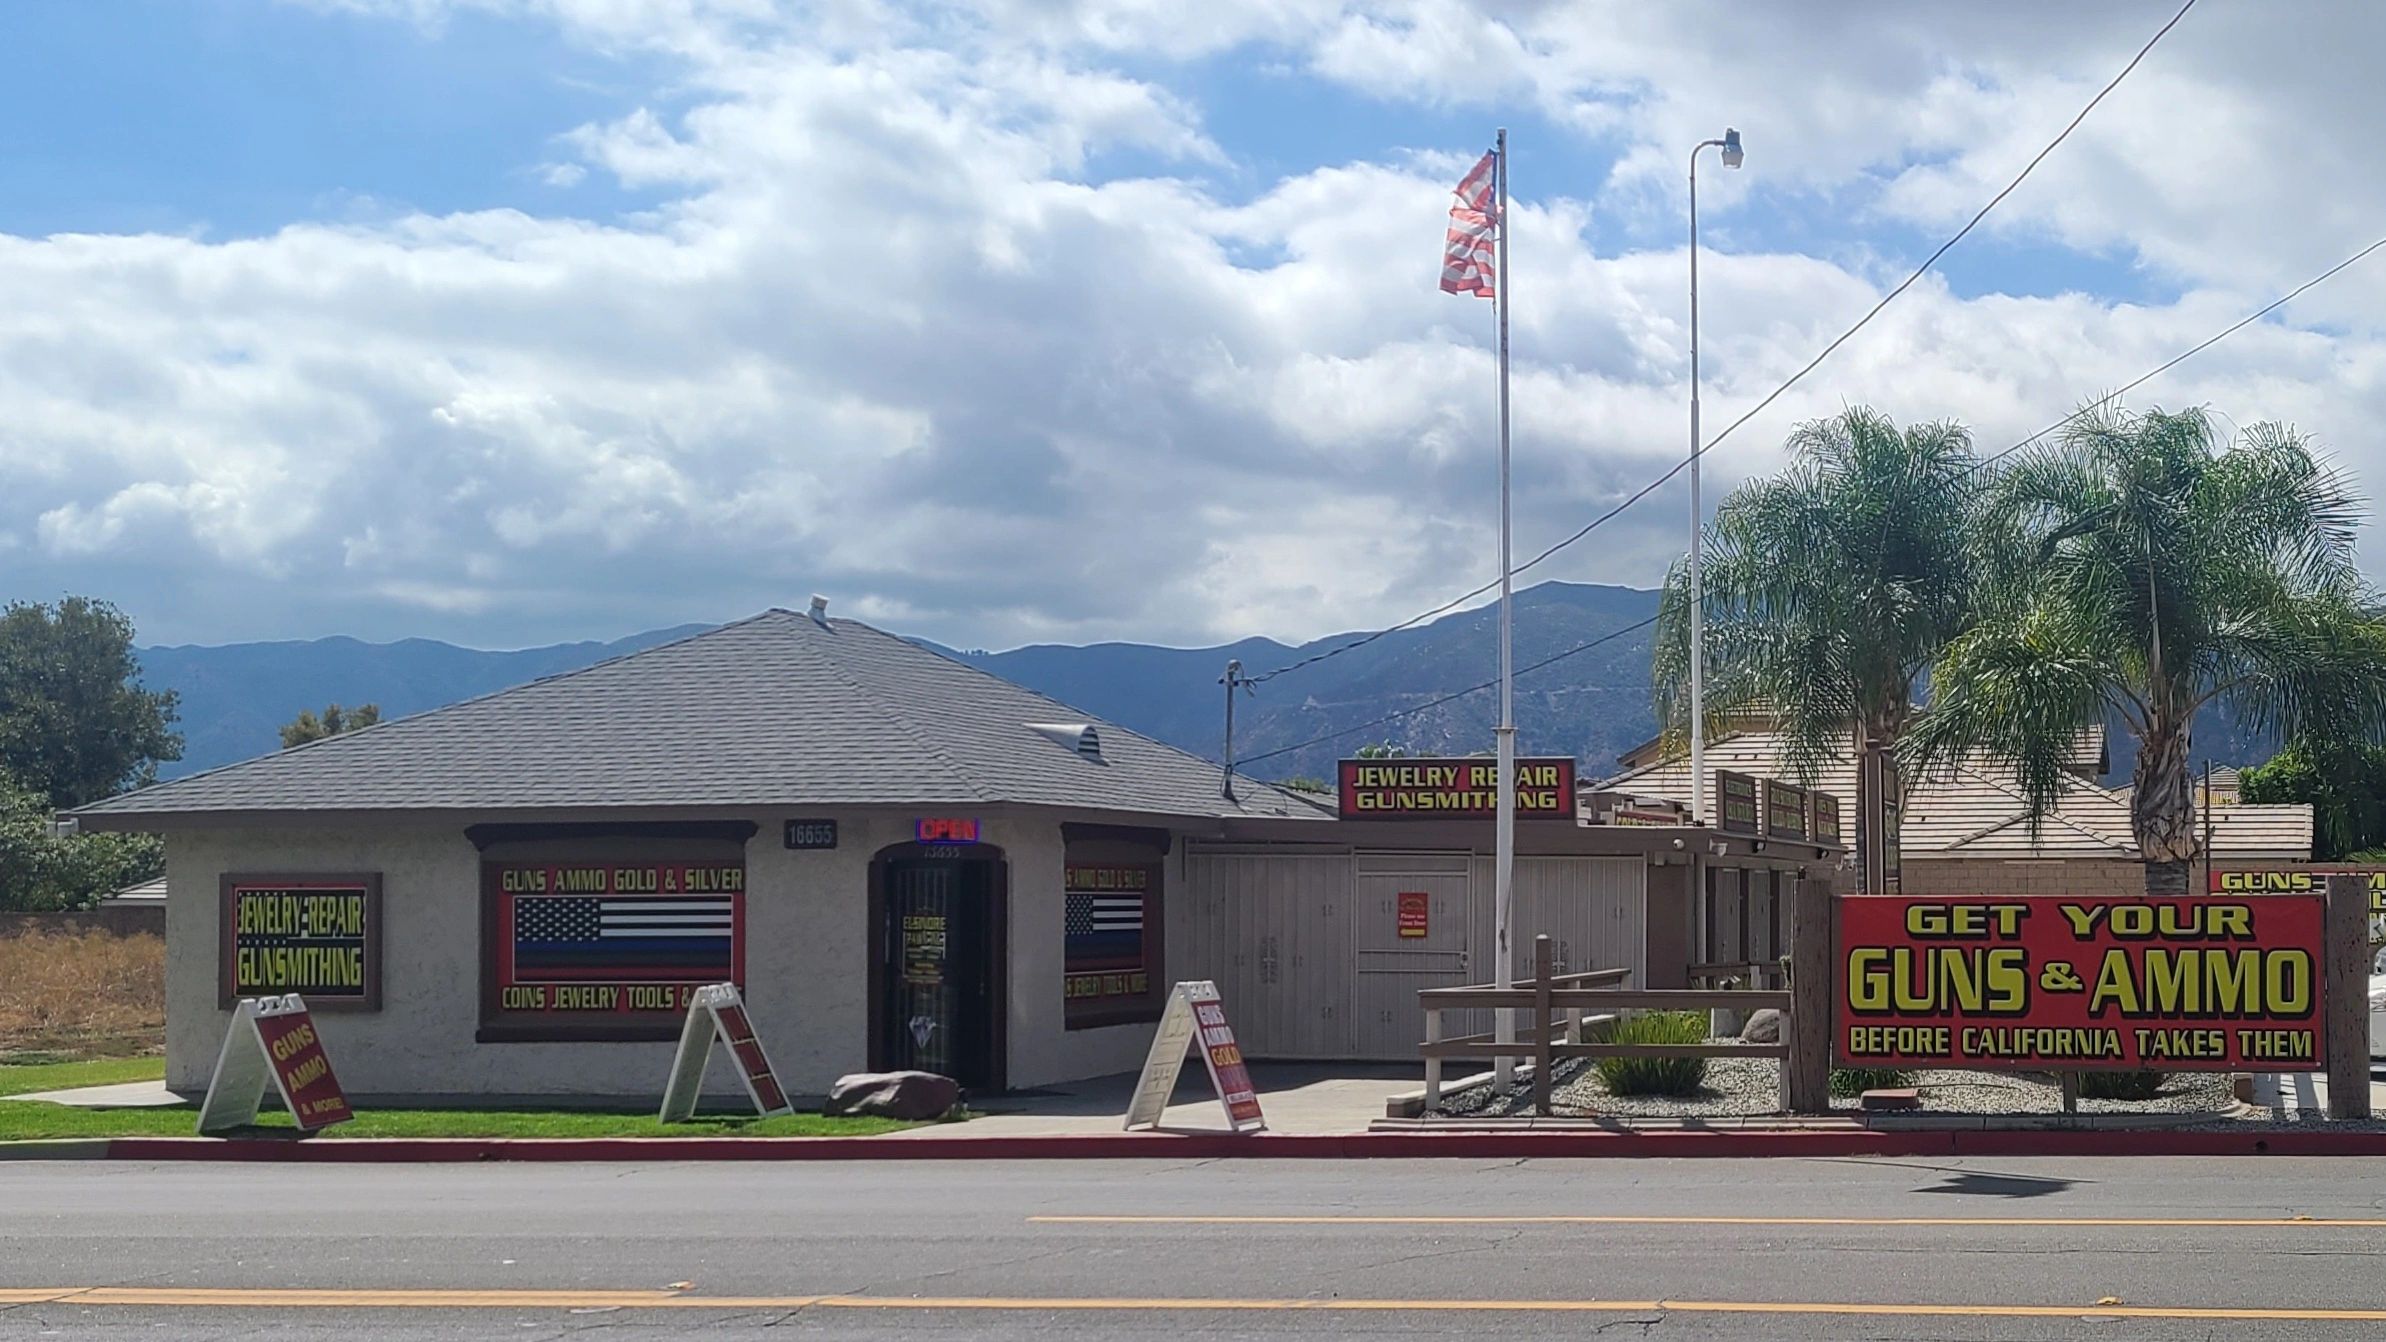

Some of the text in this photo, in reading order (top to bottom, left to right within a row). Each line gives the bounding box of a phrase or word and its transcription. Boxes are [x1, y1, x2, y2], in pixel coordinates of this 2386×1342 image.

[1353, 766, 1558, 787] JEWELRY REAIR
[1356, 791, 1557, 809] GUNSMITHNG
[788, 825, 832, 844] 16655
[919, 817, 977, 840] OPEN
[502, 868, 743, 892] GUNS AMMO GOLD & SILVER
[2221, 872, 2312, 889] GUNS
[238, 896, 362, 934] JEWELRY REPAIR
[1906, 904, 2253, 936] GET YOUR
[238, 947, 362, 986] GUNSMITHING
[1849, 948, 2310, 1014] GUNS & AMMO
[502, 987, 546, 1009] COINS
[552, 986, 619, 1009] JEWELRY
[627, 986, 674, 1008] TOOLS
[272, 1023, 315, 1062] GUNS
[1850, 1027, 2313, 1058] BEFORE CALIFORNIA TAKES THEM
[1211, 1047, 1242, 1067] GOLD
[287, 1054, 327, 1093] AMMO
[301, 1103, 312, 1115] &
